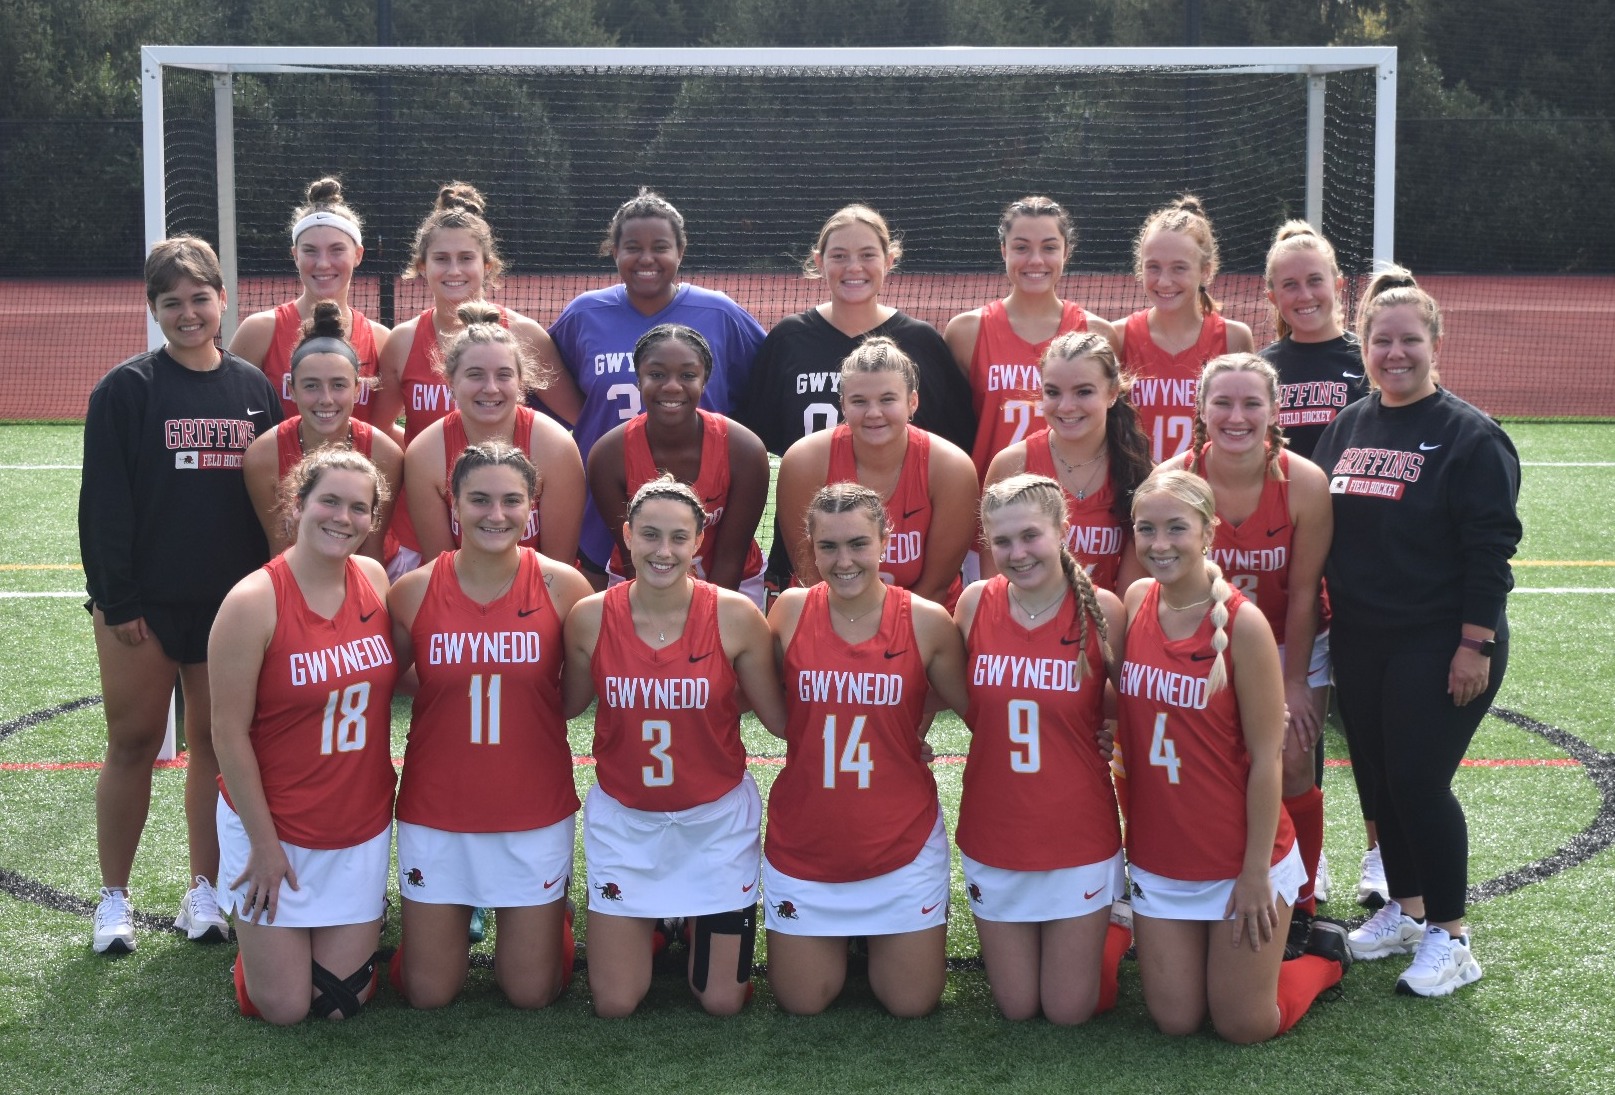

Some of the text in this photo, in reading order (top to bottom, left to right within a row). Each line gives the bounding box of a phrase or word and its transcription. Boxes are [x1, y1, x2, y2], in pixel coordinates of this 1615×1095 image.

[412, 383, 457, 411] GWY
[1130, 378, 1200, 408] GWYNE
[164, 418, 256, 450] GRIFFINS
[1278, 410, 1332, 426] FIELD HOCKEY
[1332, 447, 1425, 483] GRIFFINS
[1348, 479, 1400, 497] FIELD HOCKEY
[289, 634, 393, 687] GWYNEDD
[429, 631, 540, 665] GWYNEDD
[798, 670, 903, 706] GWYNEDD
[973, 654, 1081, 692] GWYNEDD
[1119, 660, 1209, 710] GWYNEDD
[467, 673, 502, 745] 11
[605, 676, 710, 709] GWYNEDD
[319, 680, 371, 756] 18
[1008, 698, 1041, 774] 9
[642, 719, 675, 788] 3
[822, 713, 875, 790] 14
[1149, 712, 1182, 784] 4
